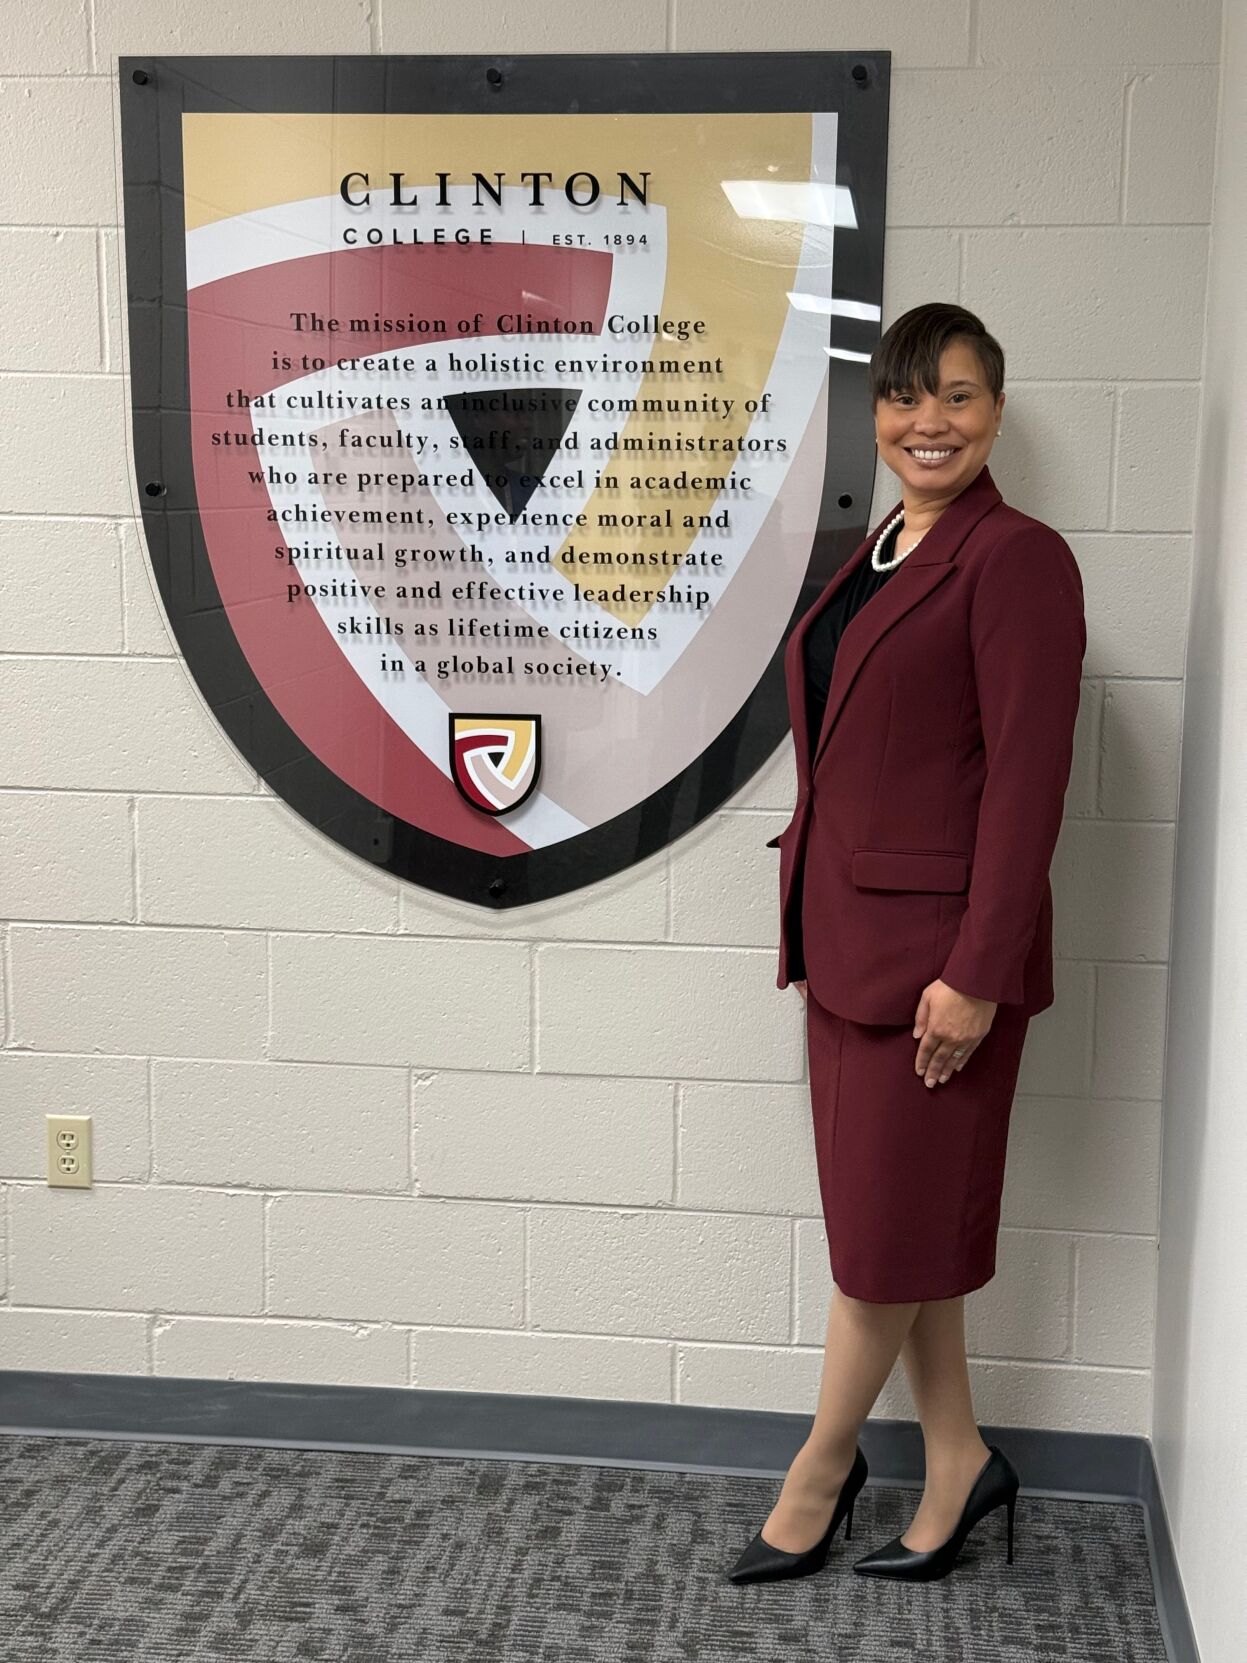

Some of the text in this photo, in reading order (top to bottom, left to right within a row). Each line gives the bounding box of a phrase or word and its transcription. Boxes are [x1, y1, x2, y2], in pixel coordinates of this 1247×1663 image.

[340, 172, 651, 207] CLINTON
[343, 228, 648, 246] COLLEGE EST. 1894
[290, 313, 706, 341] The mission of Clinton College
[271, 351, 723, 374] is to create a holistic environment
[226, 389, 771, 419] that cultivates an inclusive community of
[211, 428, 787, 454] students, faculty, staff, and administrators
[248, 466, 752, 492] who are prepared to excel in academic
[267, 504, 730, 532] achievement, experience moral and
[275, 541, 723, 567] spiritual growth, and demonstrate
[287, 579, 710, 611] positive and effective leadership
[337, 617, 658, 640] skills as lifetime citizens
[380, 653, 622, 681] in a global society.
